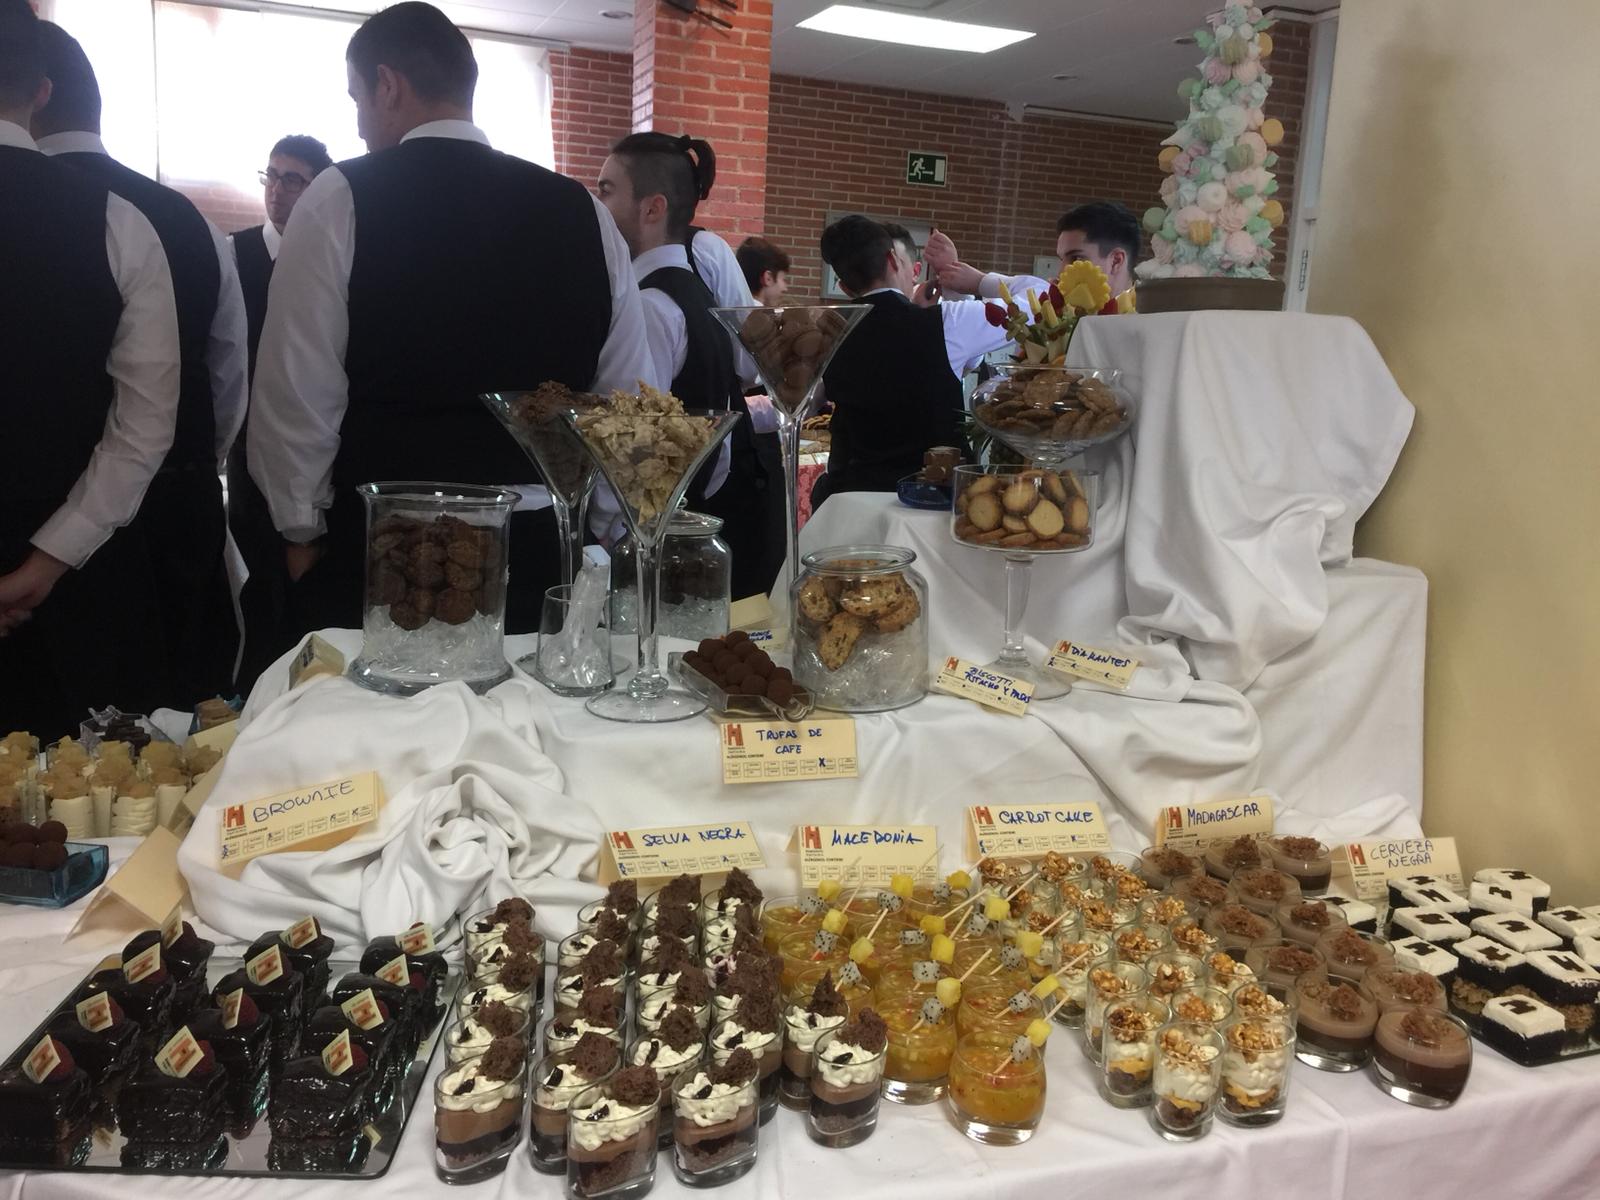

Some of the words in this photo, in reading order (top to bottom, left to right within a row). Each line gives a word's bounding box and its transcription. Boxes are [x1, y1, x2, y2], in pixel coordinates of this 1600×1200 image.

[756, 729, 797, 741] TRUFAS
[808, 728, 822, 737] DE
[252, 780, 354, 822] BROWNIE
[998, 810, 1051, 825] CARROT
[1055, 810, 1093, 823] CAKE
[1187, 802, 1261, 828] MADAGASCAR
[642, 832, 690, 847] SELVA
[698, 827, 746, 842] NEGRA
[1370, 840, 1434, 860] CERVEZA
[1388, 852, 1432, 868] NEGRA
